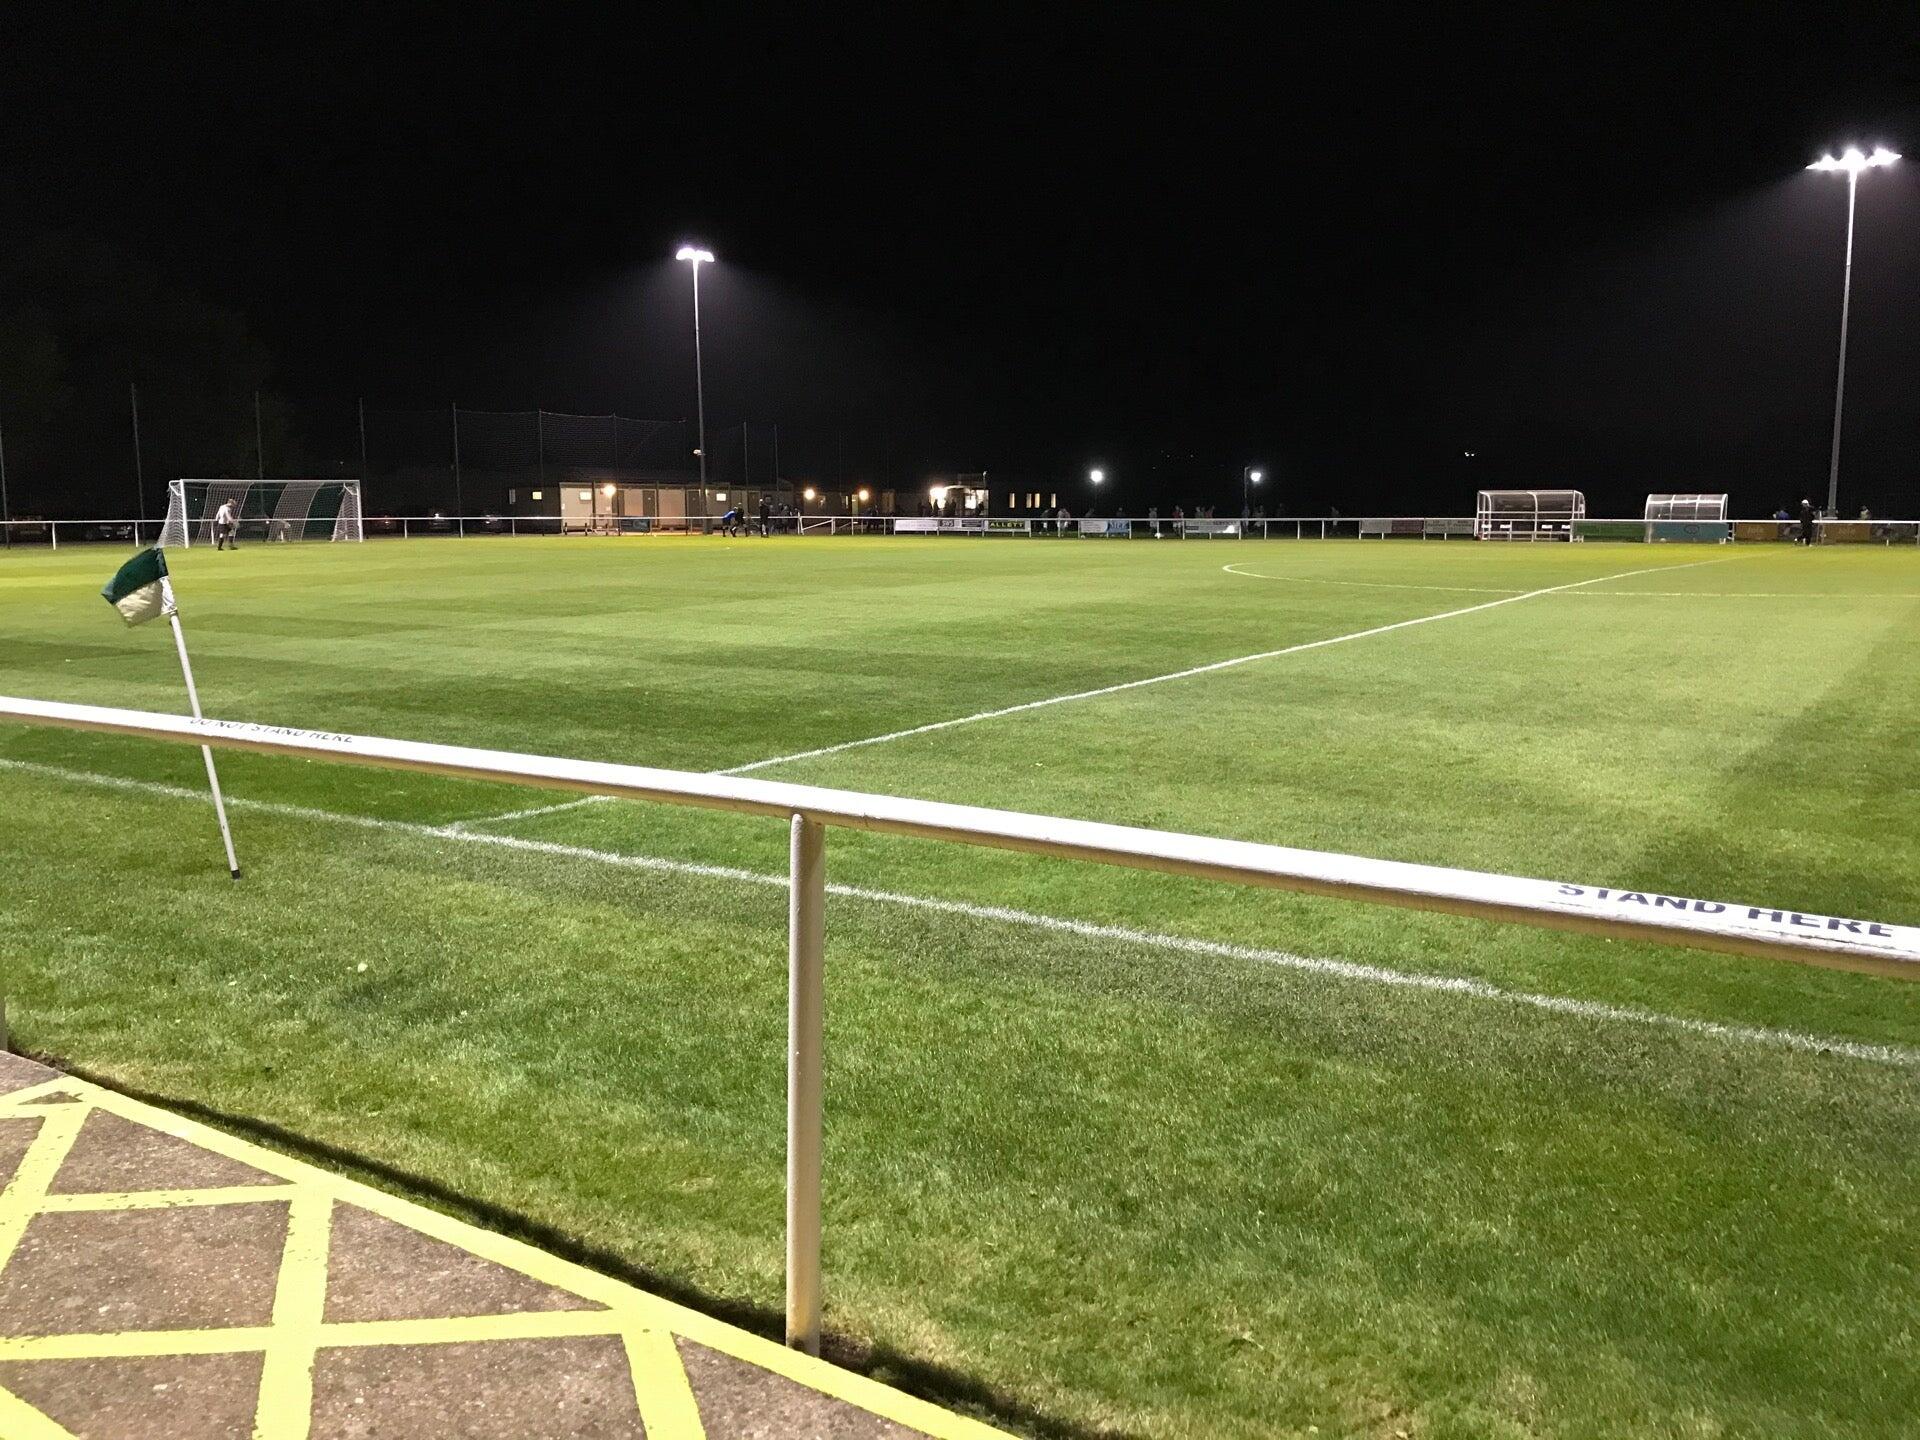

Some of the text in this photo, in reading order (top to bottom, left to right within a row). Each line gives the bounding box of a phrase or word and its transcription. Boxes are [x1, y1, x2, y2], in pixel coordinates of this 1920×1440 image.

[214, 721, 246, 730] NOT
[250, 725, 306, 737] STAND
[308, 732, 353, 743] HERE
[1558, 884, 1894, 938] STAND HERE
